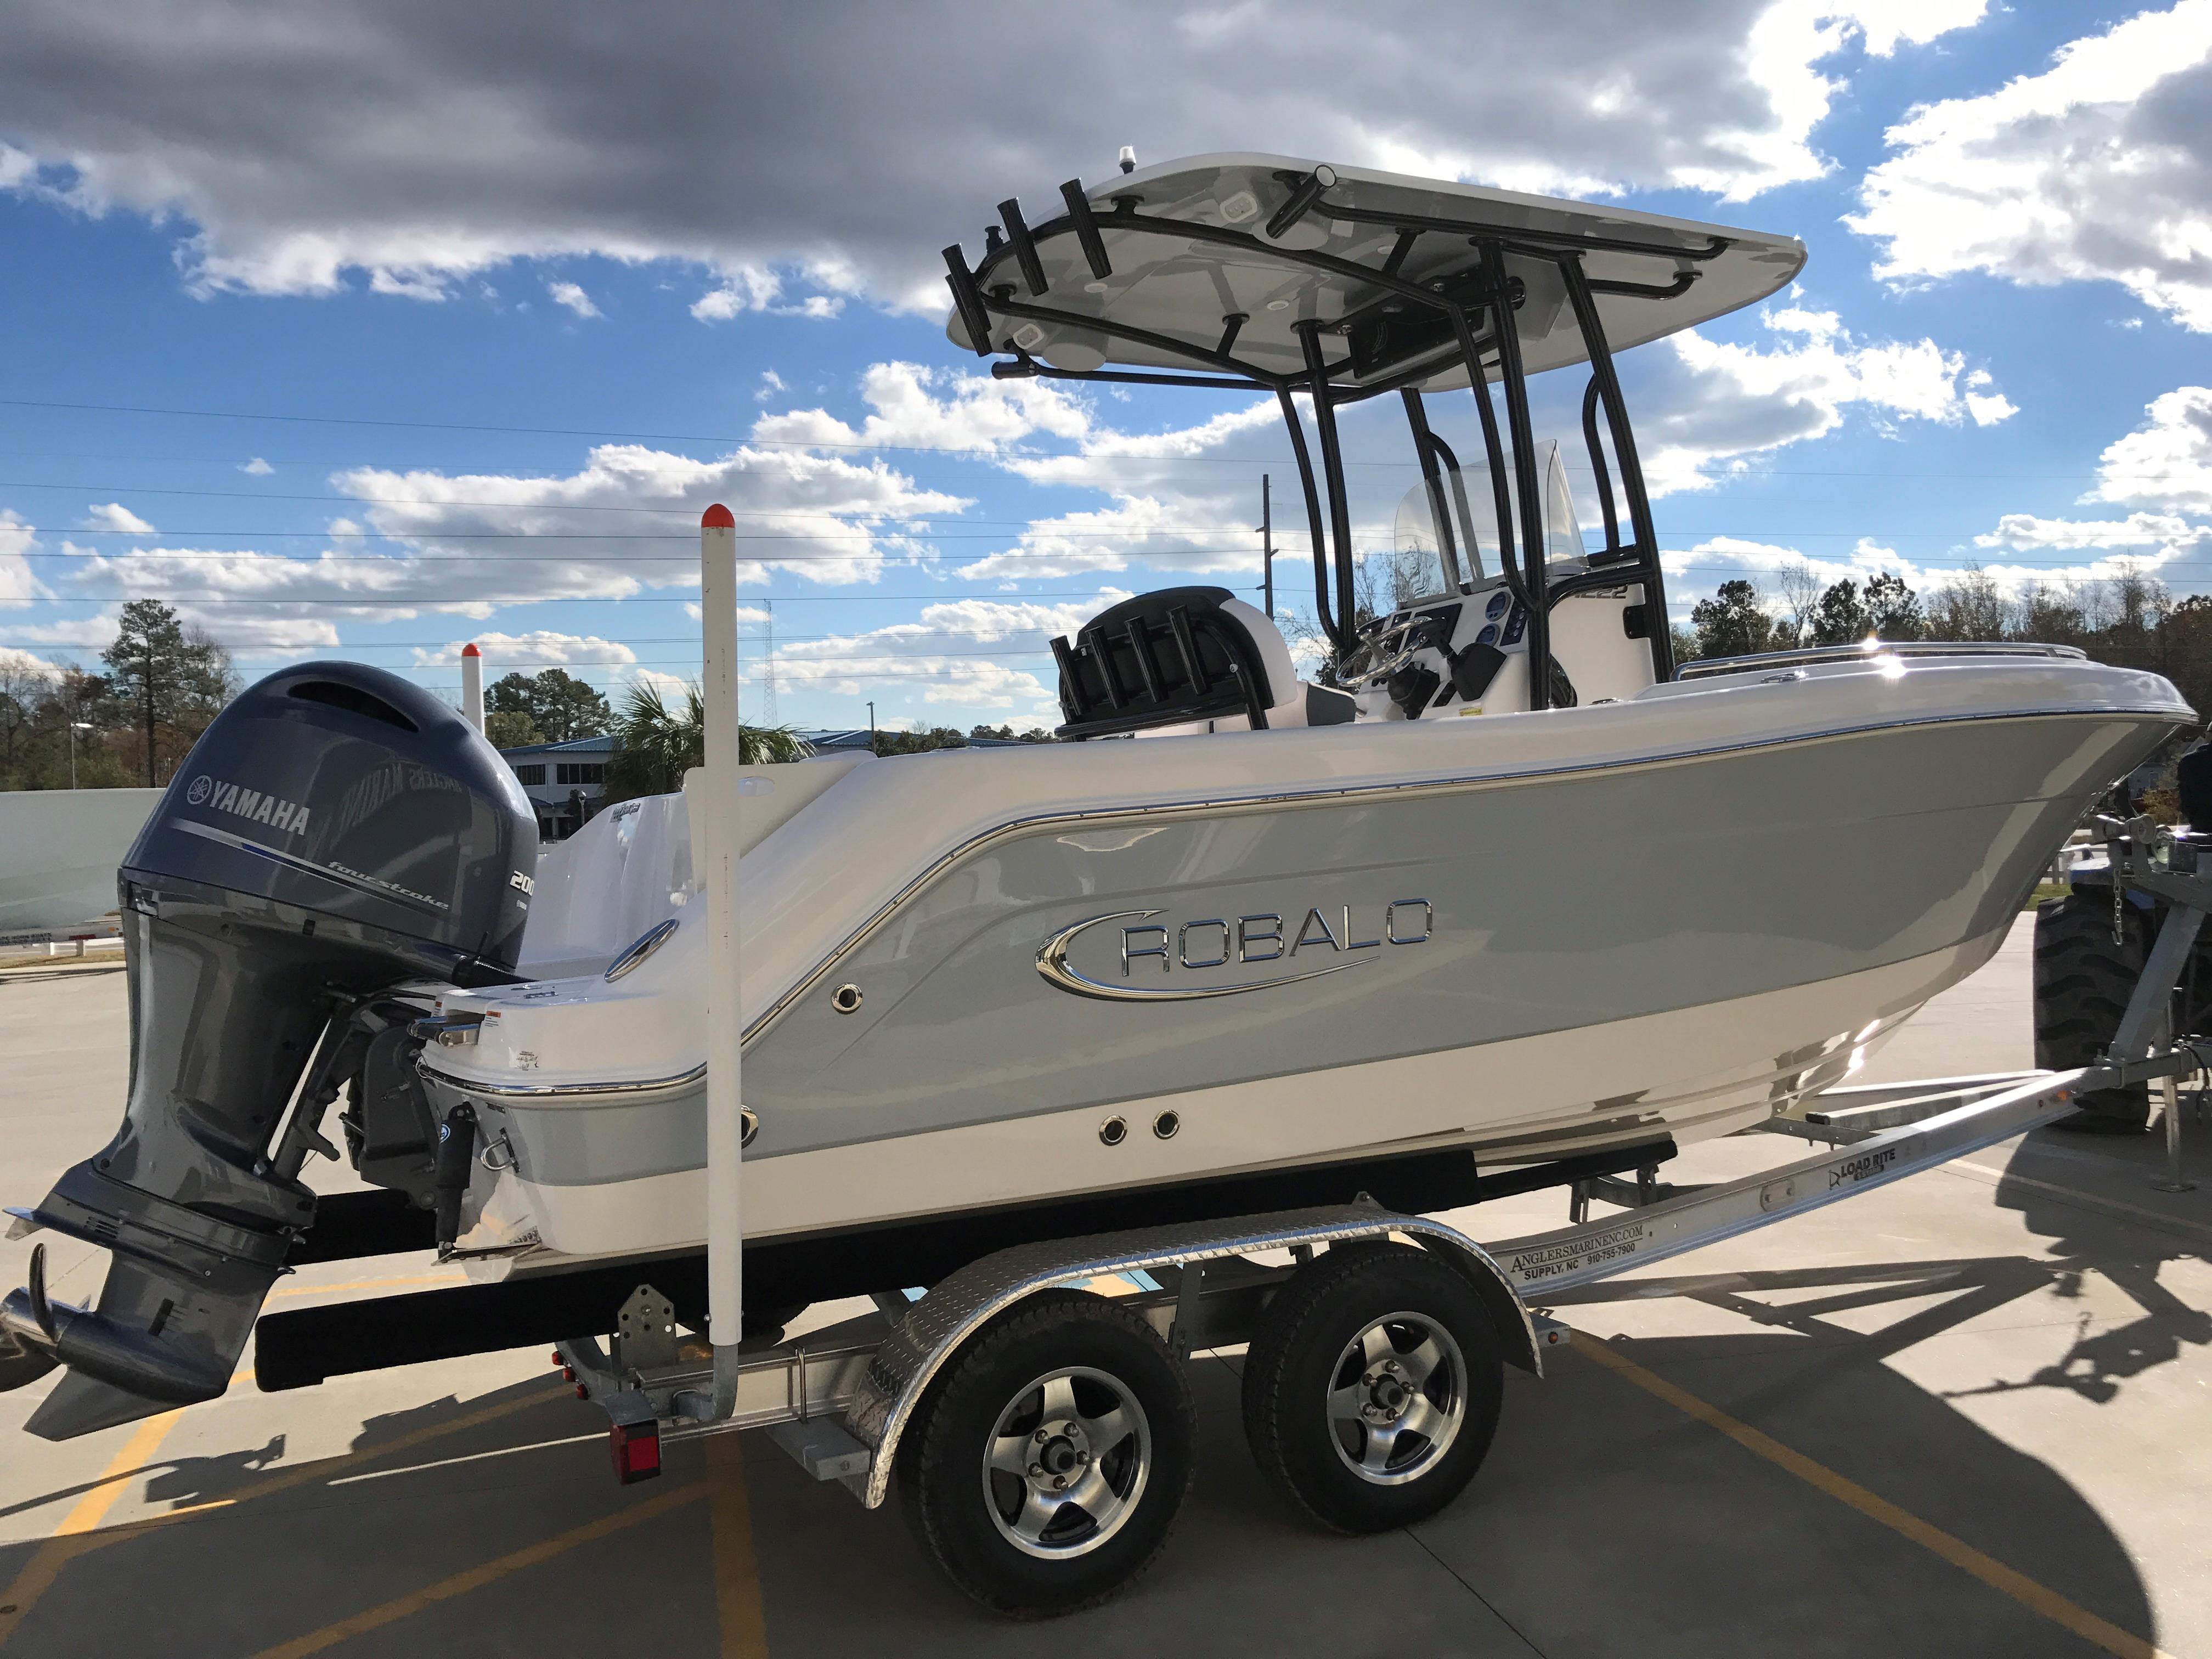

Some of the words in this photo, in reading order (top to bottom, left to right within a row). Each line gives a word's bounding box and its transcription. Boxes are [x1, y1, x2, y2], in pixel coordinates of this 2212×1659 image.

[210, 780, 310, 836] YAMAHA
[510, 870, 535, 896] 200
[1120, 898, 1433, 977] ROBALO
[1841, 1156, 1870, 1178] LOAD
[1872, 1148, 1895, 1166] RITE
[1510, 1225, 1643, 1273] ANGLERSMARINENC.COM
[1524, 1264, 1564, 1280] SUPPLY,
[1566, 1260, 1579, 1271] NC
[1587, 1243, 1635, 1265] 910-755-7900
